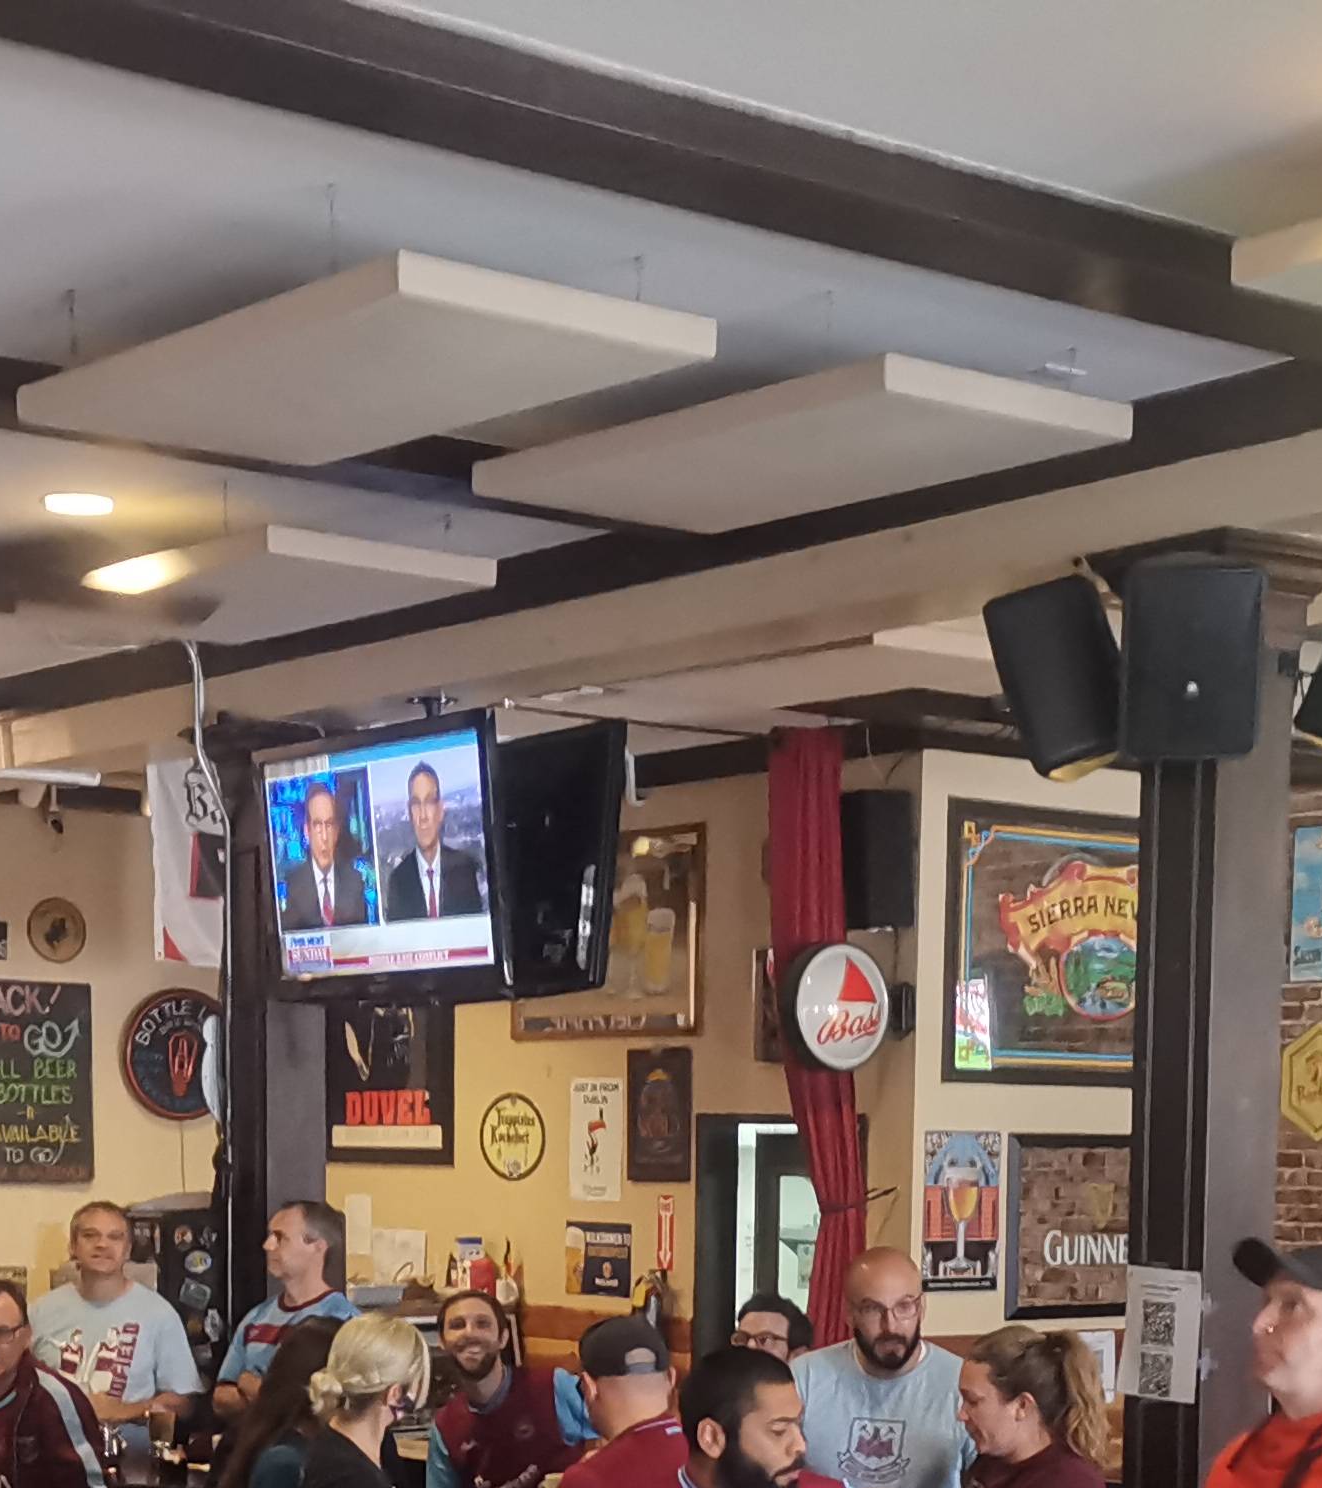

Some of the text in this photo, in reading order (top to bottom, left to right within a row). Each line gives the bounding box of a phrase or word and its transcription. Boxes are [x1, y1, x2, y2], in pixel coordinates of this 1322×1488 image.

[1028, 895, 1099, 933] SIERRA
[0, 1023, 22, 1042] TO
[23, 1021, 65, 1057] GO
[135, 1000, 192, 1046] BOTTLE
[33, 1058, 77, 1080] BEER
[345, 1089, 432, 1126] DUVEL
[1043, 1229, 1129, 1266] GUINNE
